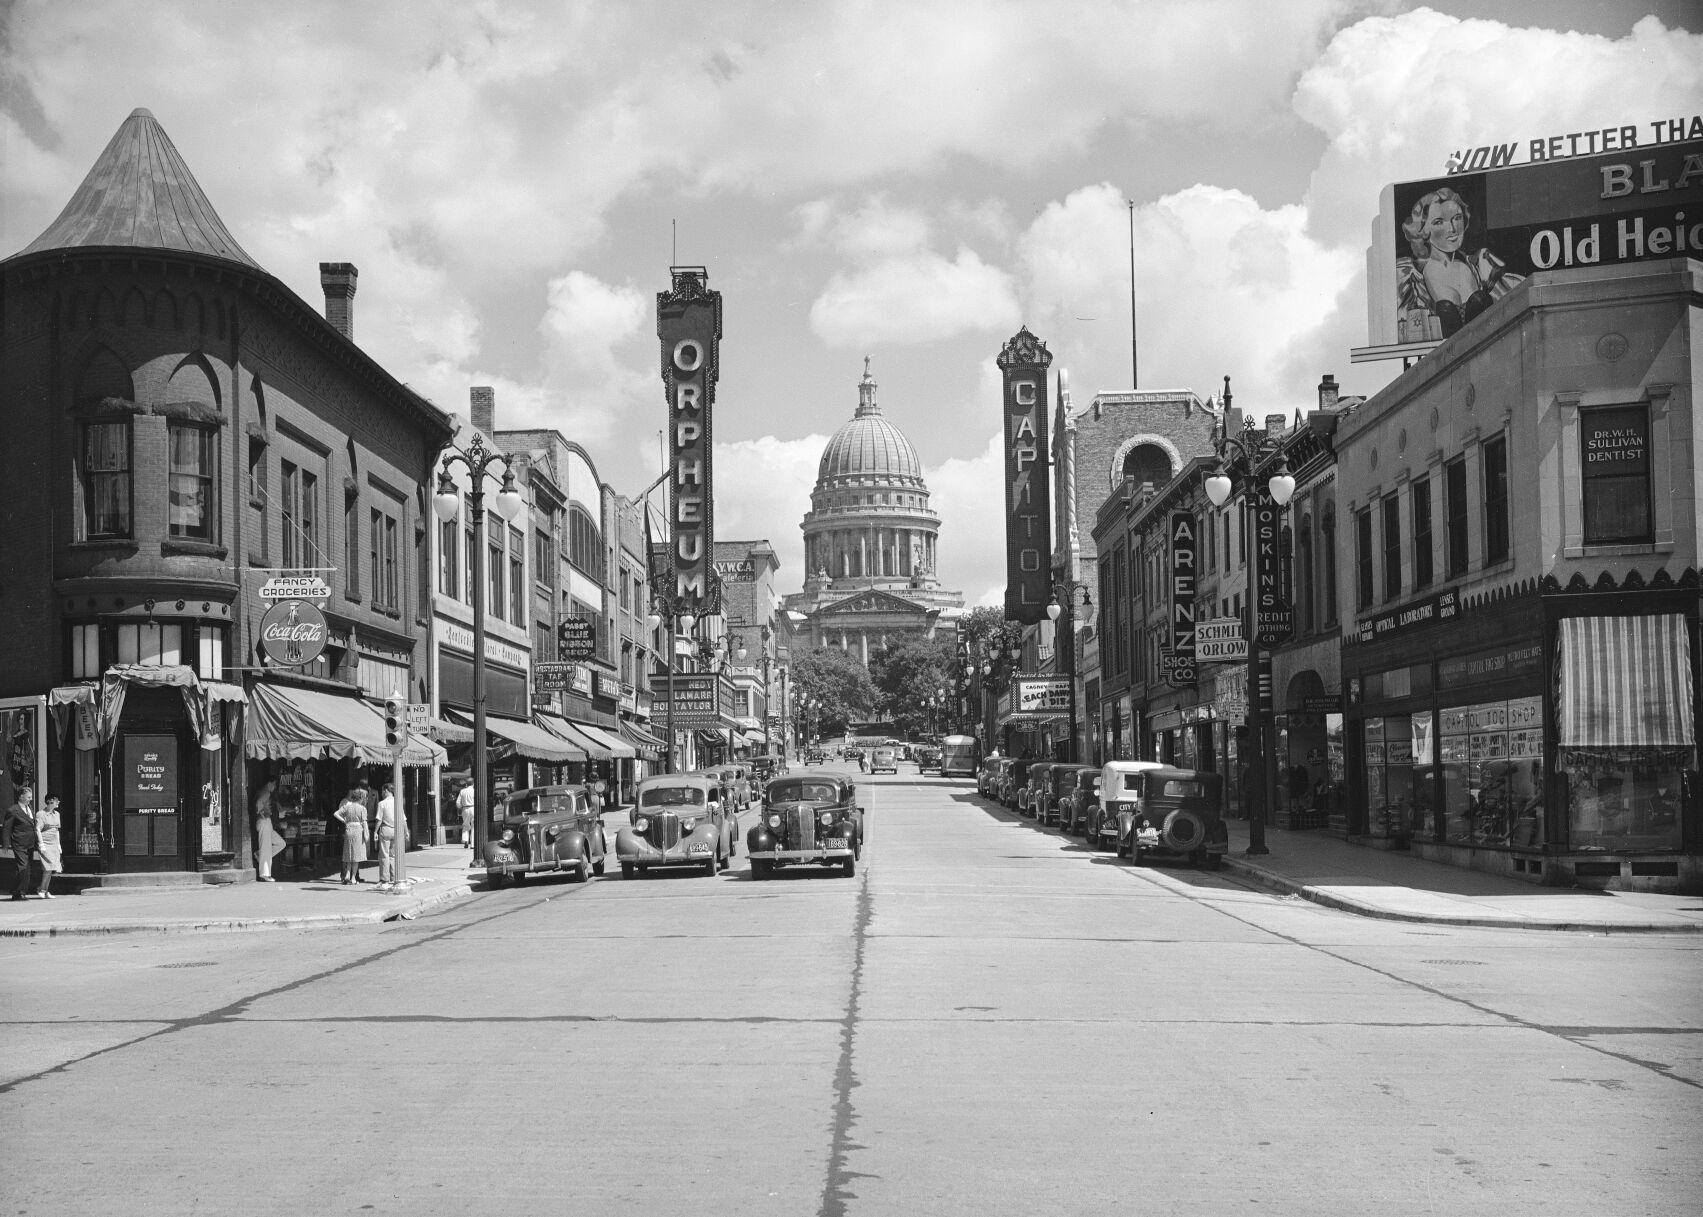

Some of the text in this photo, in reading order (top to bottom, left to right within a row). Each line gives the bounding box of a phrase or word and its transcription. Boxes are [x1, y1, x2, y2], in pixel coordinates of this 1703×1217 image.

[1447, 142, 1518, 175] NOW
[1530, 125, 1638, 162] BETTER
[1530, 224, 1600, 268] Old
[1588, 437, 1643, 449] SULLIVAN
[1588, 449, 1643, 462] DENTIST
[673, 339, 704, 598] ORPHEUM
[1016, 382, 1040, 604] CAPITOL
[1259, 494, 1275, 606] MOSKIN'S
[274, 578, 316, 586] FANCY
[1174, 521, 1195, 650] ARENZ
[262, 588, 327, 596] GROCERIES
[1258, 612, 1291, 622] REDIT
[1399, 604, 1433, 626] LABORATORY
[263, 622, 324, 642] Coca-Cola
[1259, 624, 1291, 633] OTHING
[564, 631, 589, 639] BLUE
[560, 640, 593, 648] RIBBON
[1203, 642, 1247, 656] ORLOW
[1164, 656, 1196, 667] SHOE
[535, 664, 575, 673] RESTAURANT
[1175, 669, 1197, 680] CO.
[543, 681, 567, 689] ROOM
[688, 680, 712, 689] HEDY
[674, 690, 713, 700] LAMARR
[1023, 691, 1047, 703] EACH
[653, 701, 712, 711] BO TAYLOR
[1049, 698, 1067, 706] DIE
[1489, 709, 1508, 726] TOG
[1513, 705, 1537, 724] SHOP
[137, 764, 165, 774] PURITY
[1119, 803, 1132, 811] CITY
